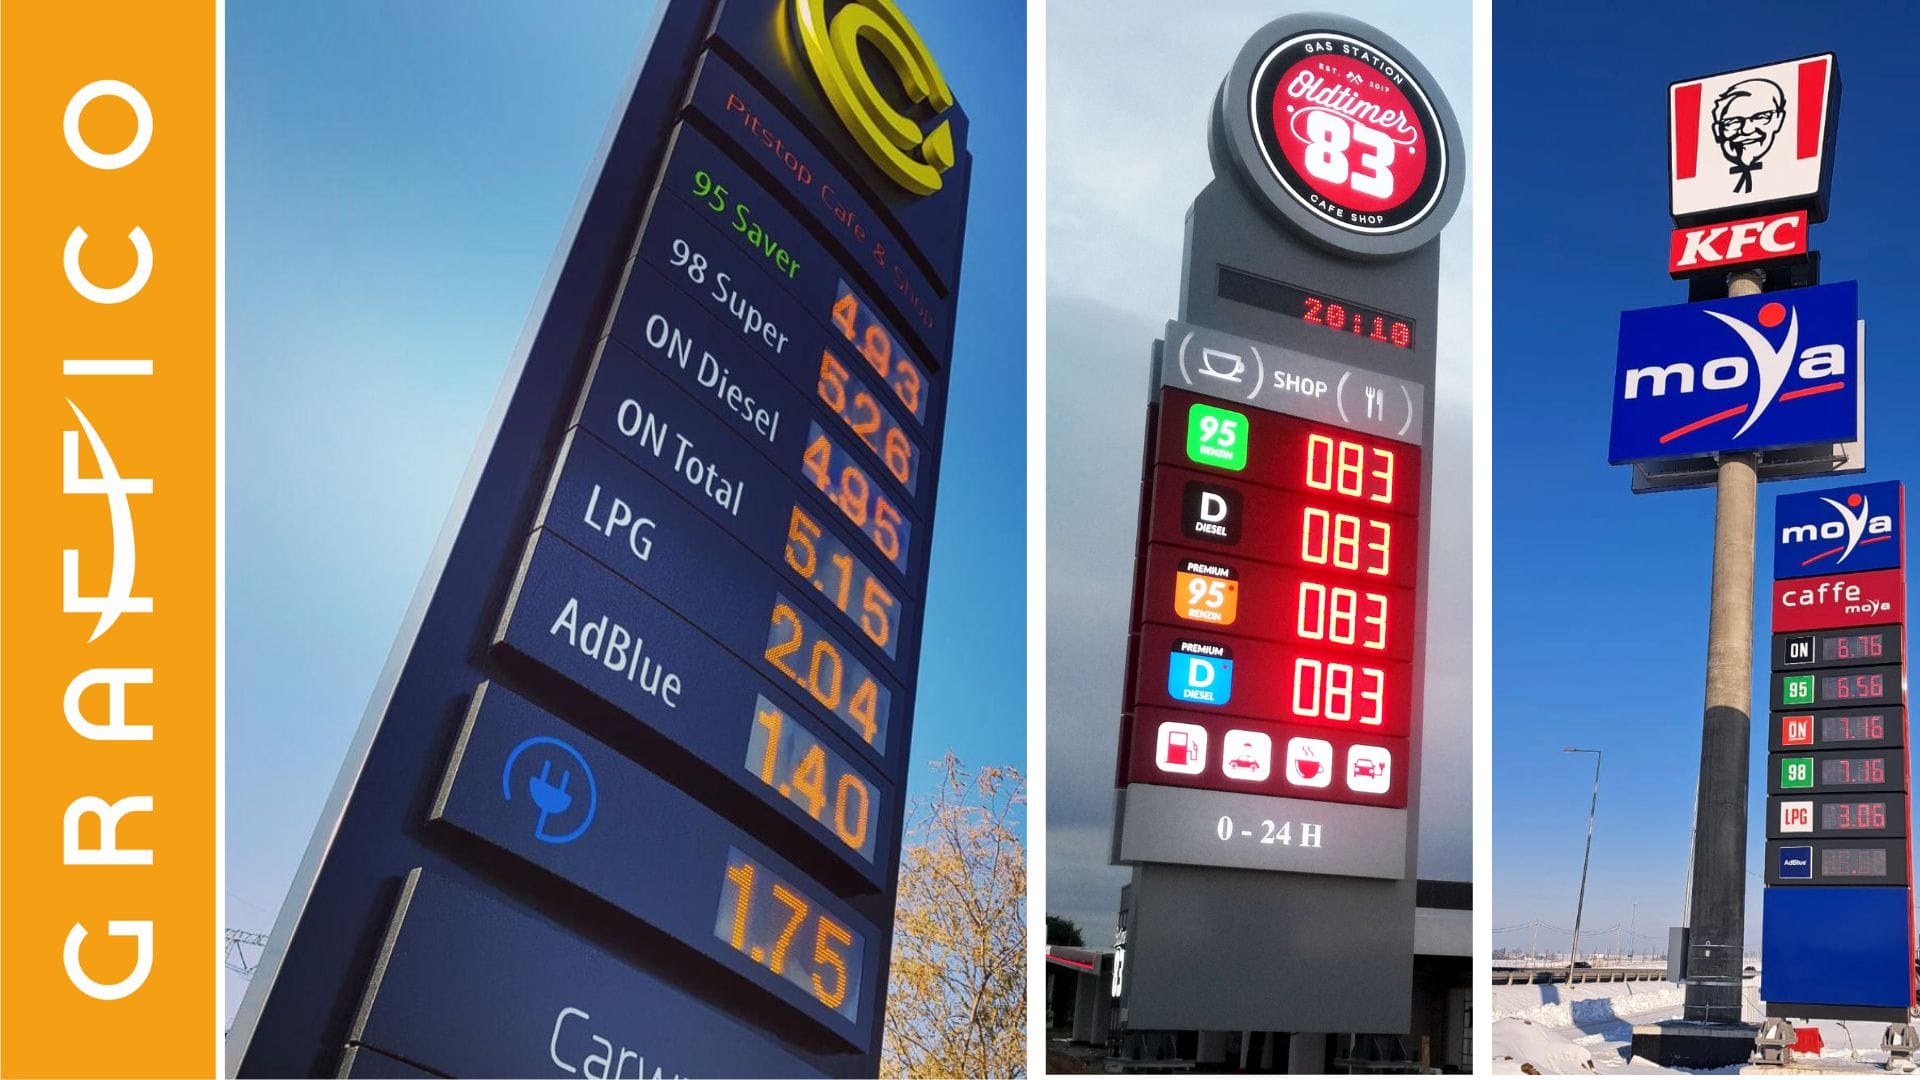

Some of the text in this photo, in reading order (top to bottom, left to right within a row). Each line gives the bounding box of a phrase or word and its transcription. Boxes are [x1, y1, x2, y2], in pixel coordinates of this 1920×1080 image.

[1304, 41, 1404, 85] GAS STATION
[1318, 62, 1341, 77] EST.
[1287, 70, 1416, 140] Oldtimer
[1304, 110, 1396, 200] 83
[726, 93, 813, 186] Pitstop
[821, 184, 867, 243] Cafe
[873, 243, 886, 268] &
[693, 170, 800, 280] 95 Saver
[1310, 194, 1384, 225] CAFE SHOP
[1676, 215, 1800, 267] KFC
[670, 239, 789, 355] 98 Super
[1303, 297, 1410, 349] 20:10
[645, 314, 780, 442] ON Diesel
[1273, 370, 1328, 398] SHOP
[817, 349, 911, 484] 5.26
[1199, 415, 1238, 447] 95
[617, 398, 744, 516] ON Total
[1199, 445, 1233, 461] BENZIN
[1305, 433, 1395, 505] 083
[584, 484, 656, 562] LPG
[1199, 491, 1228, 523] D
[1195, 521, 1228, 537] DIESEL
[1301, 506, 1391, 577] 083
[784, 504, 894, 648] 5.15
[1187, 562, 1230, 577] PREMIUM
[1188, 578, 1226, 609] 95
[1782, 581, 1860, 607] caffe
[1188, 607, 1222, 622] BENZIN
[1296, 581, 1388, 651] 083
[550, 597, 683, 708] AdBlue
[1181, 642, 1224, 657] PREMIUM
[1790, 642, 1808, 658] ON
[1837, 634, 1882, 659] 6.76
[764, 603, 878, 746] 2.04
[1187, 657, 1215, 689] D
[1837, 674, 1883, 699] 6.56
[1183, 688, 1215, 702] DIESEL
[1292, 657, 1385, 726] 083
[1789, 681, 1807, 698] 95
[1788, 721, 1807, 739] ON
[1839, 715, 1884, 740] 7.16
[757, 708, 869, 850] 1.40
[1788, 764, 1806, 781] 98
[1839, 759, 1884, 783] 7.16
[1216, 815, 1233, 841] 0
[1260, 819, 1292, 846] 24
[1299, 823, 1322, 848] H
[1785, 808, 1807, 826] LPG
[1839, 803, 1886, 829] 3.06
[727, 862, 852, 1009] 1.75
